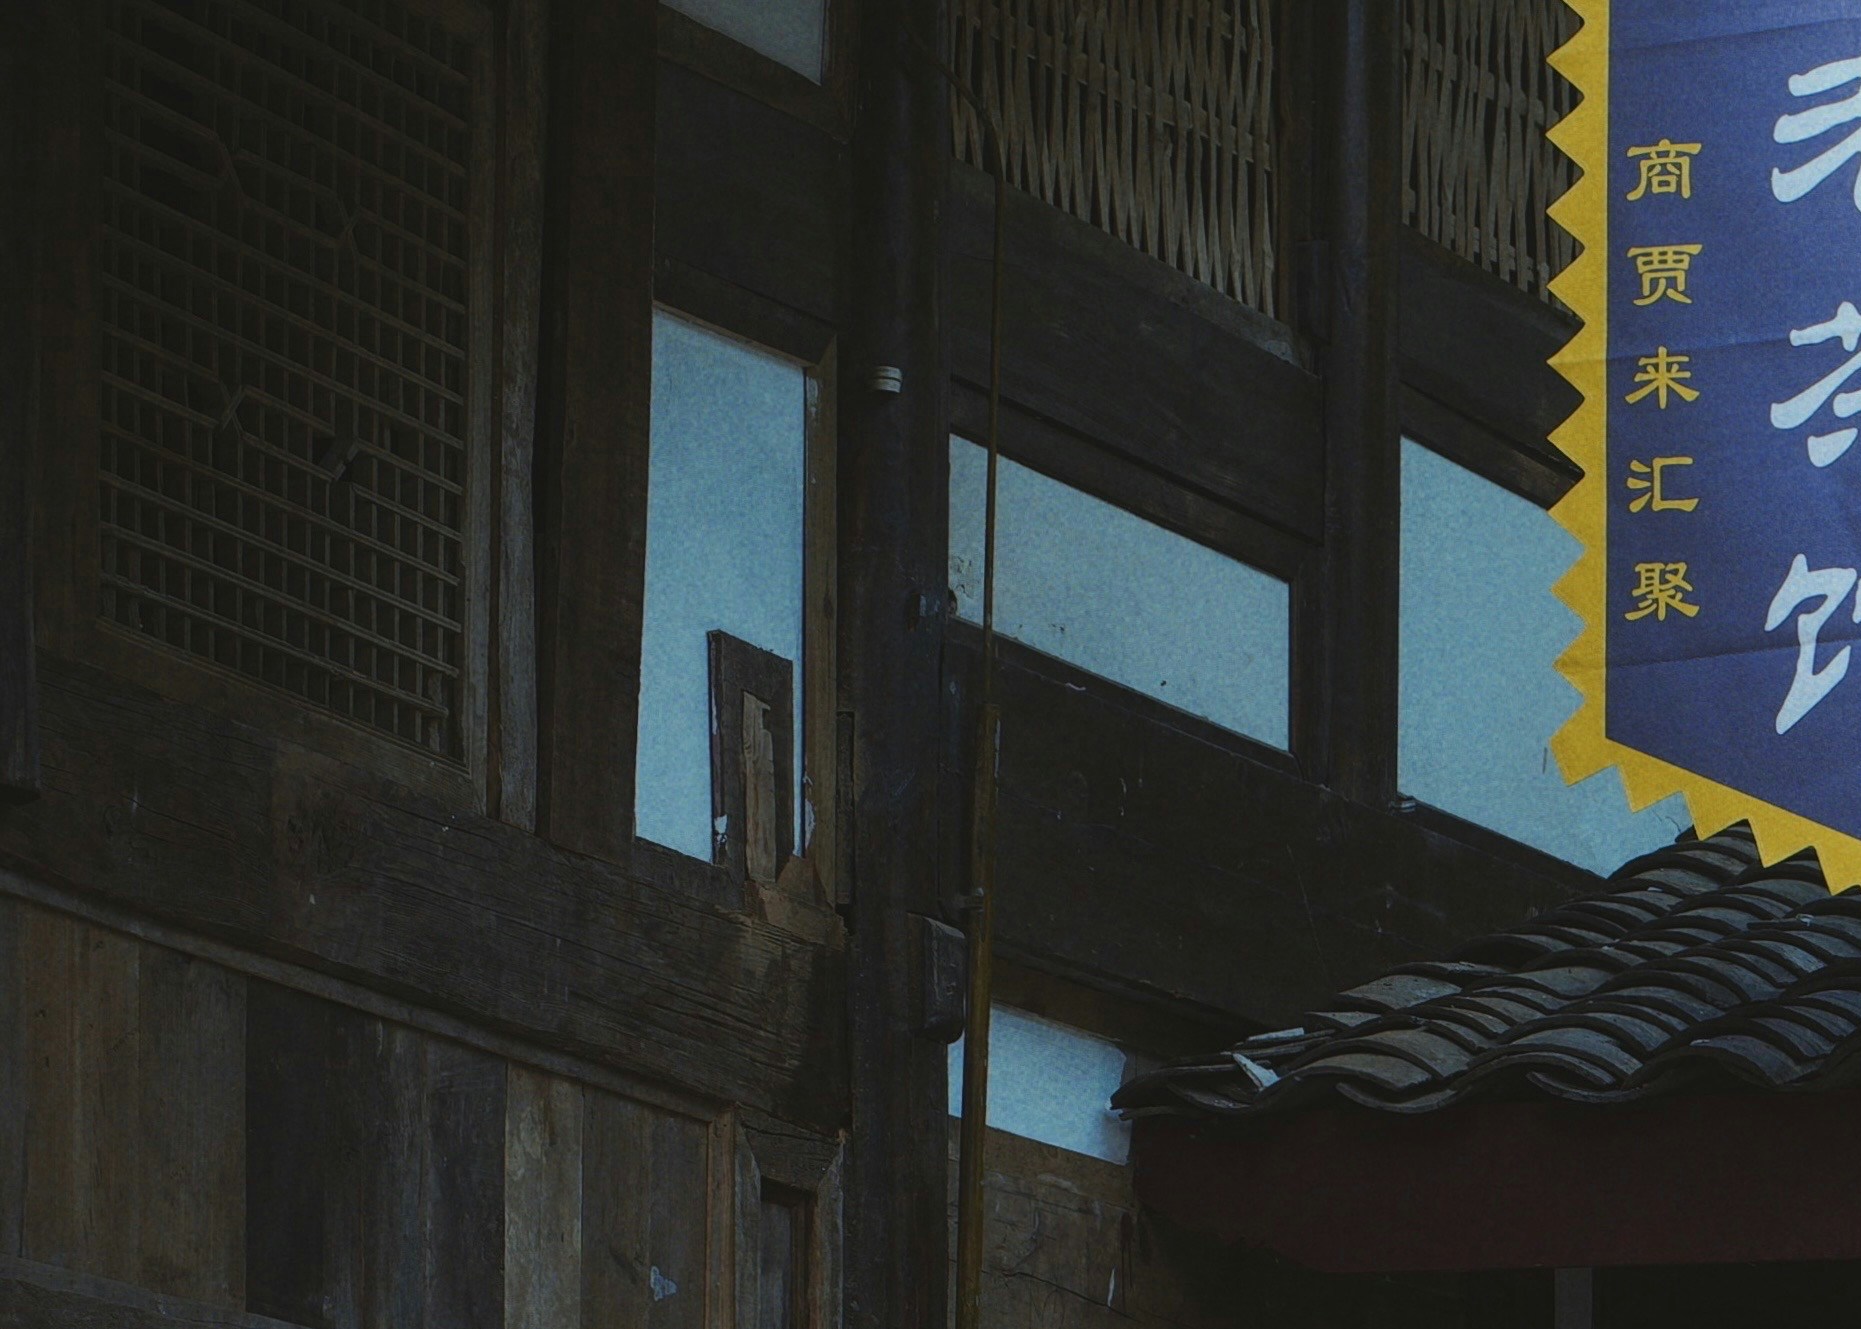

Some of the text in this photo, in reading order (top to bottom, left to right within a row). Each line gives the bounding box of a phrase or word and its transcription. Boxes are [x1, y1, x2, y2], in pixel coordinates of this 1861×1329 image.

[1624, 138, 1703, 622] 商贾来汇聚
